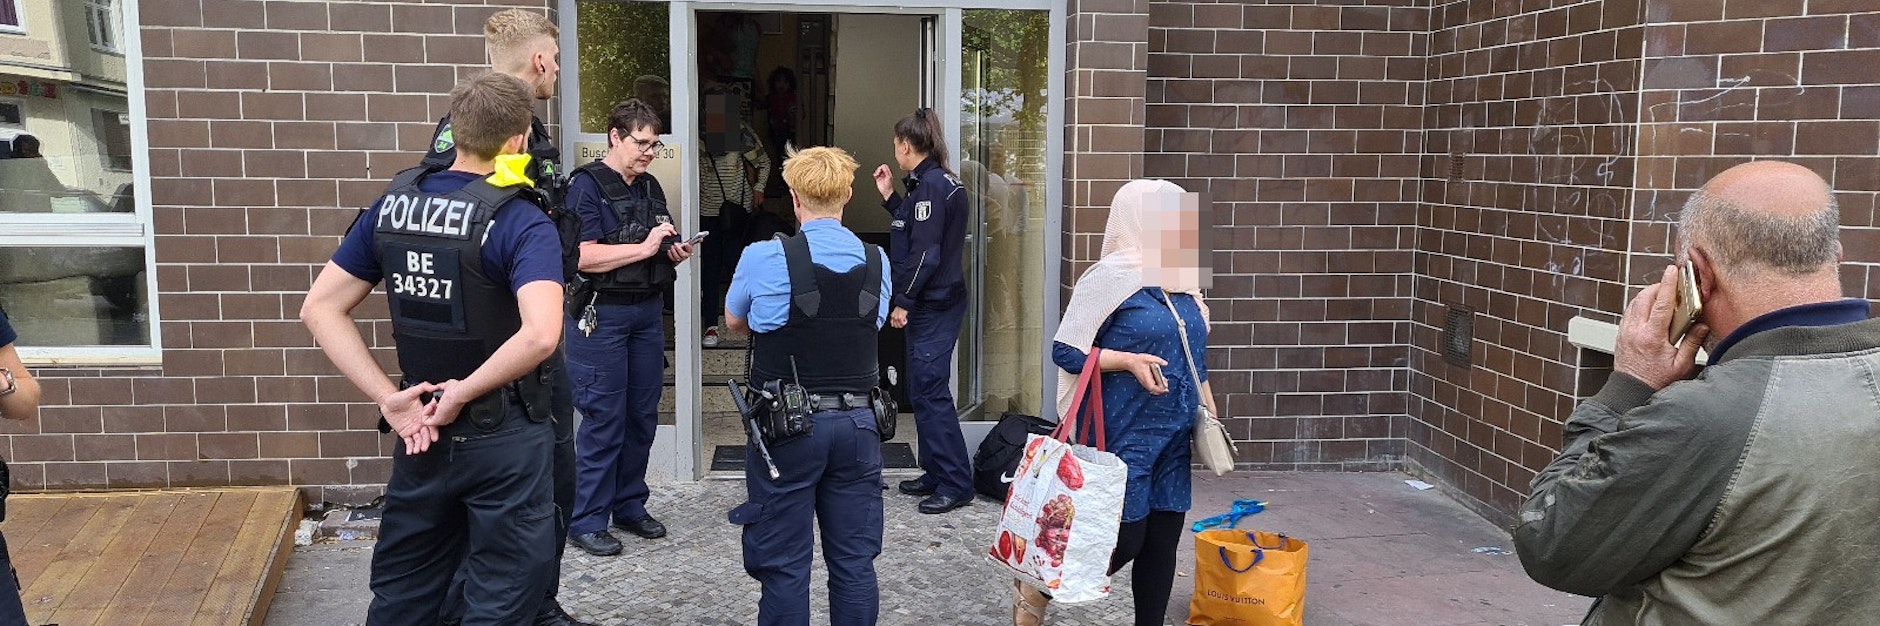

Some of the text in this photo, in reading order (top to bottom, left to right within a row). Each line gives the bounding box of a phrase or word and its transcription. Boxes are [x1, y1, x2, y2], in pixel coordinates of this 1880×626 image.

[663, 148, 674, 159] 30
[377, 194, 474, 236] POLIZEI
[406, 250, 435, 275] BE
[392, 272, 453, 300] 34327
[1207, 589, 1265, 606] LOUIS VUITTON
